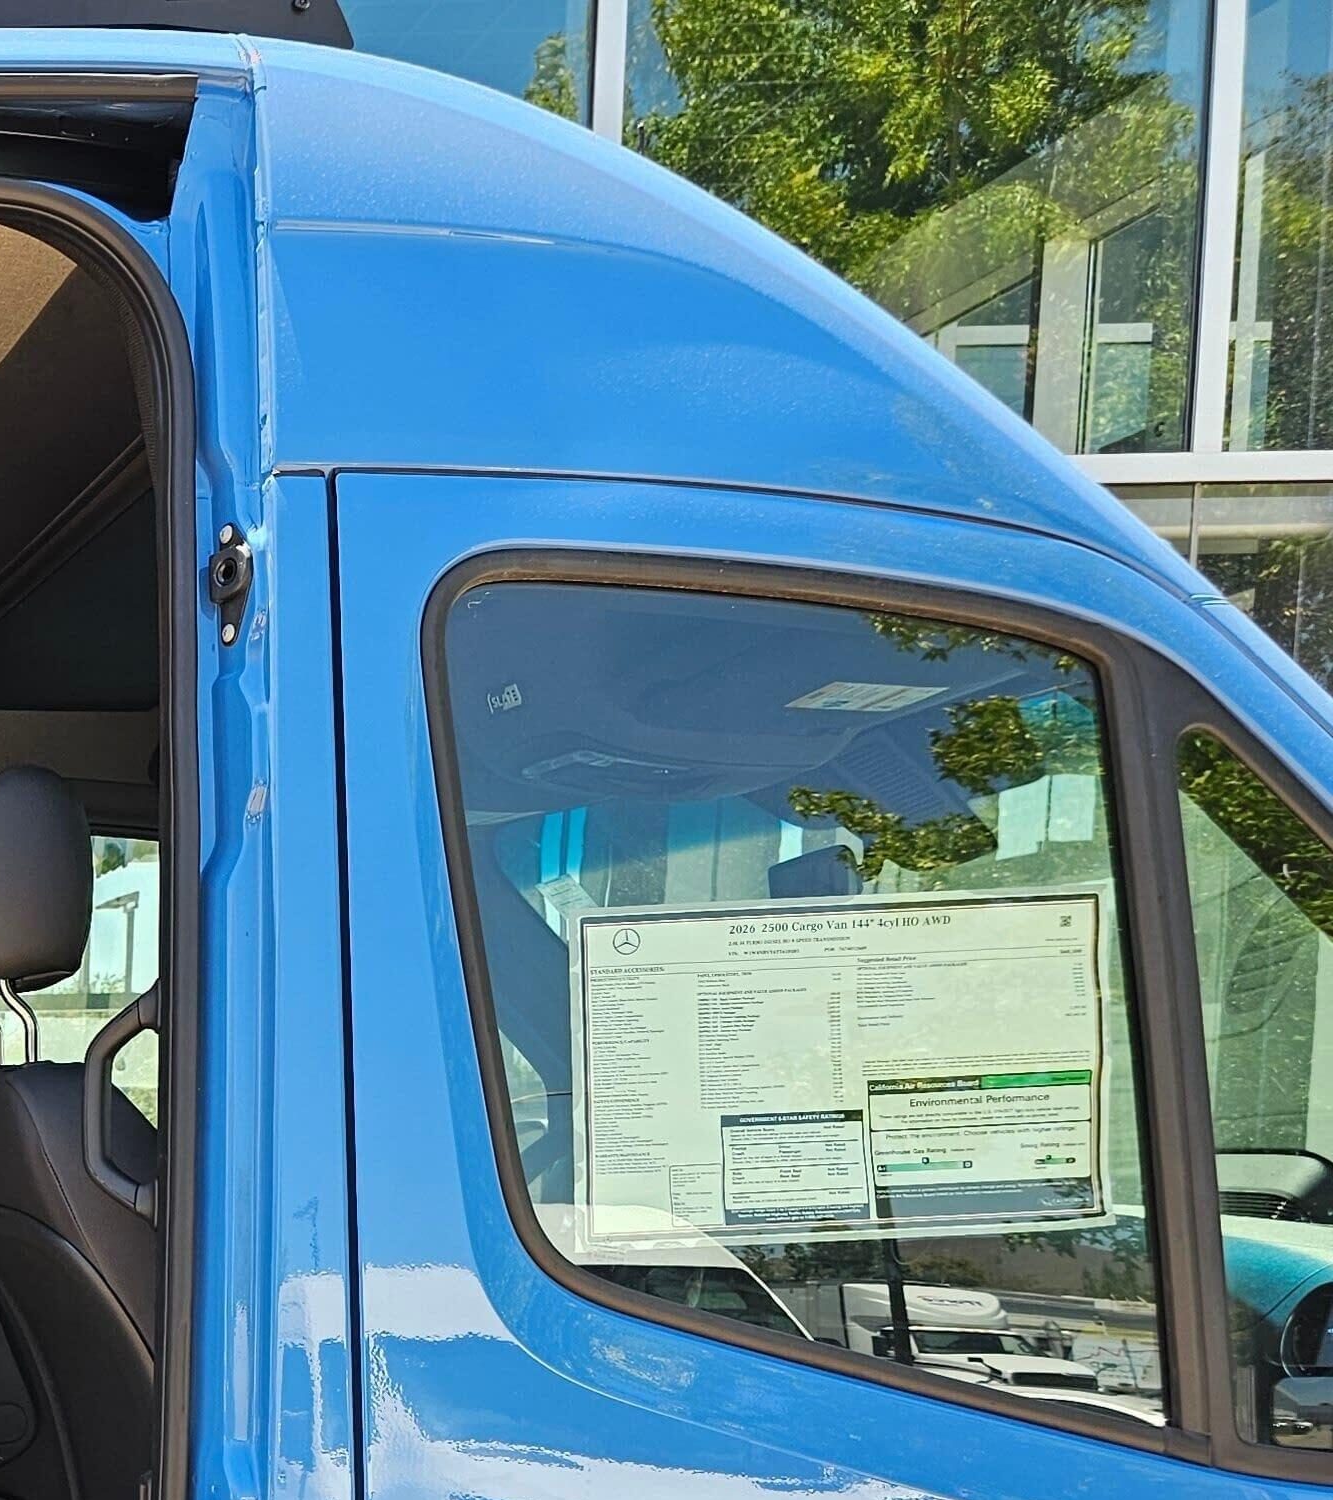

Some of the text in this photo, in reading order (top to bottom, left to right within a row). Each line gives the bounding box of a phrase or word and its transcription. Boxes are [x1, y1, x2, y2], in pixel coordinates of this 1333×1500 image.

[729, 924, 756, 935] 2026
[761, 922, 789, 933] 2500
[791, 920, 823, 933] Cargo
[826, 919, 848, 931] Van
[877, 917, 899, 930] 4cyl
[902, 916, 919, 928] HO
[922, 914, 951, 926] AWD
[869, 1082, 903, 1092] California
[904, 1081, 916, 1090] Air
[957, 1079, 980, 1088] Board
[909, 1093, 1050, 1108] Environmental Performance
